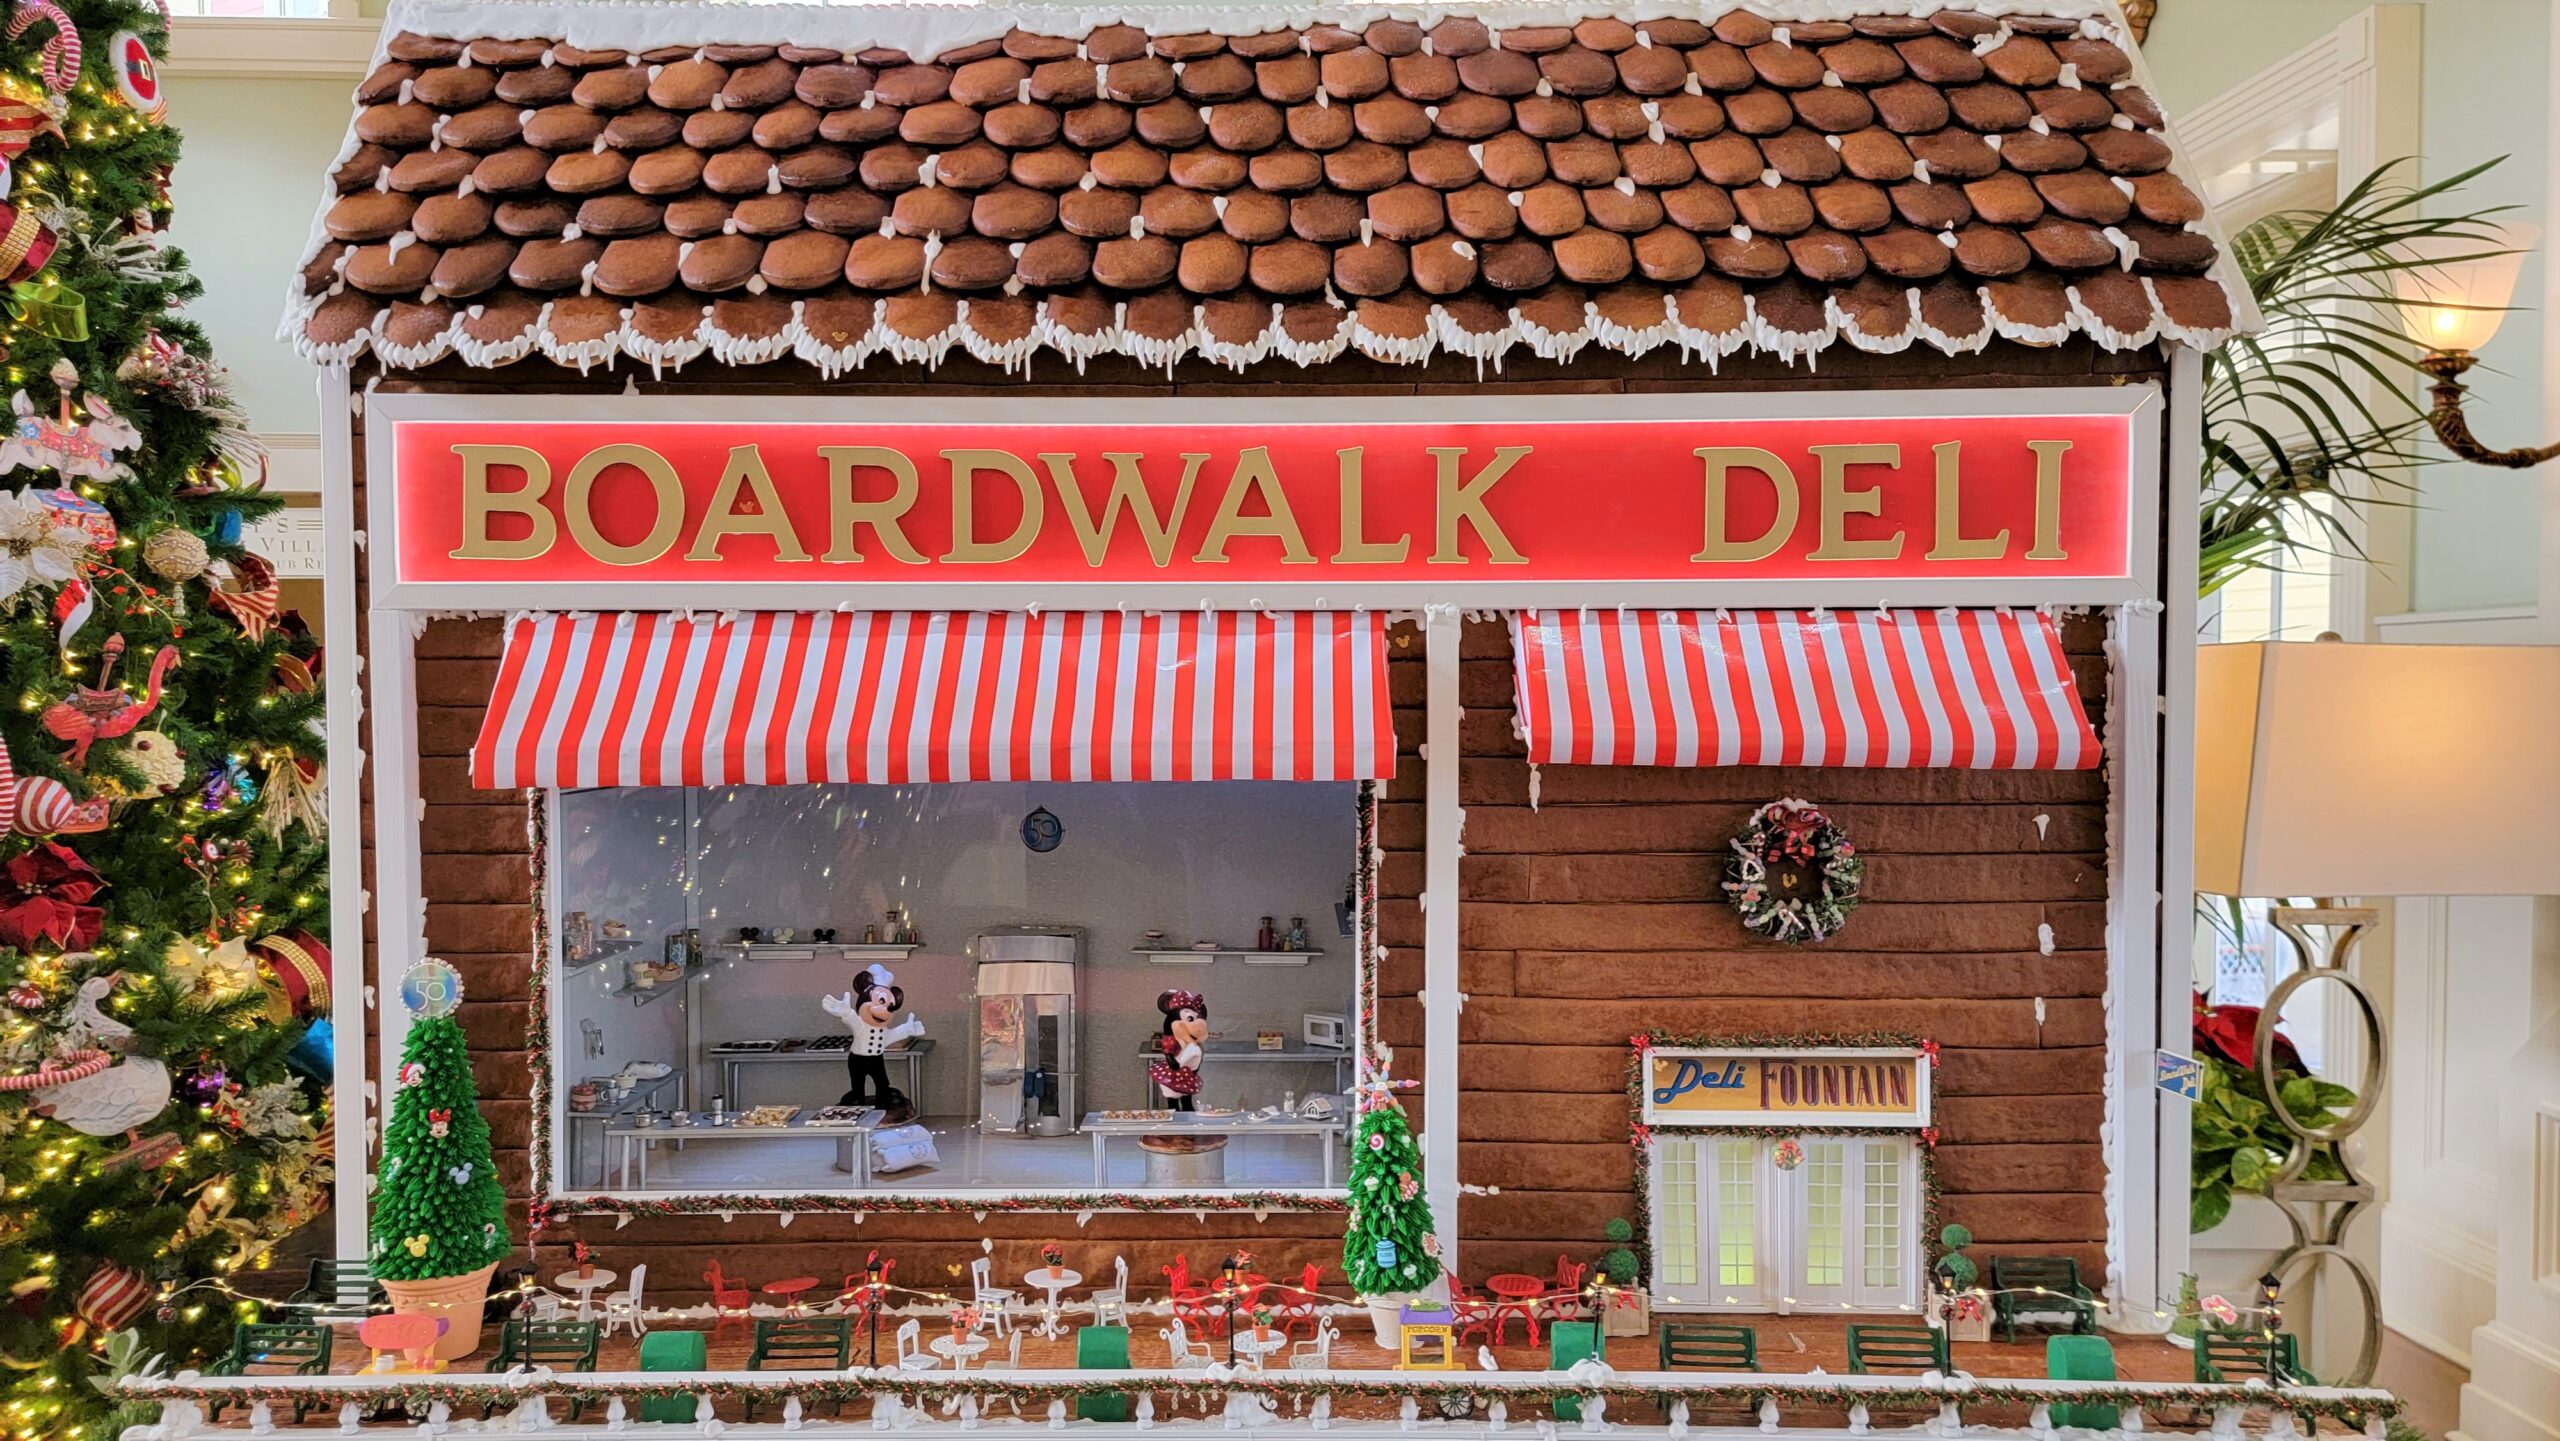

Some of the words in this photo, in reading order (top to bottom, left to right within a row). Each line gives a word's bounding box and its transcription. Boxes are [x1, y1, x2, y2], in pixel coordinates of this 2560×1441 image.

[449, 443, 1533, 567] BOARDWALK
[1690, 440, 2073, 563] DELI
[261, 537, 323, 552] VILL
[416, 980, 447, 1011] 50
[1652, 1059, 1745, 1104] Deli
[1760, 1058, 1908, 1110] FOUNTAIN
[1407, 1325, 1448, 1333] POPCORN
